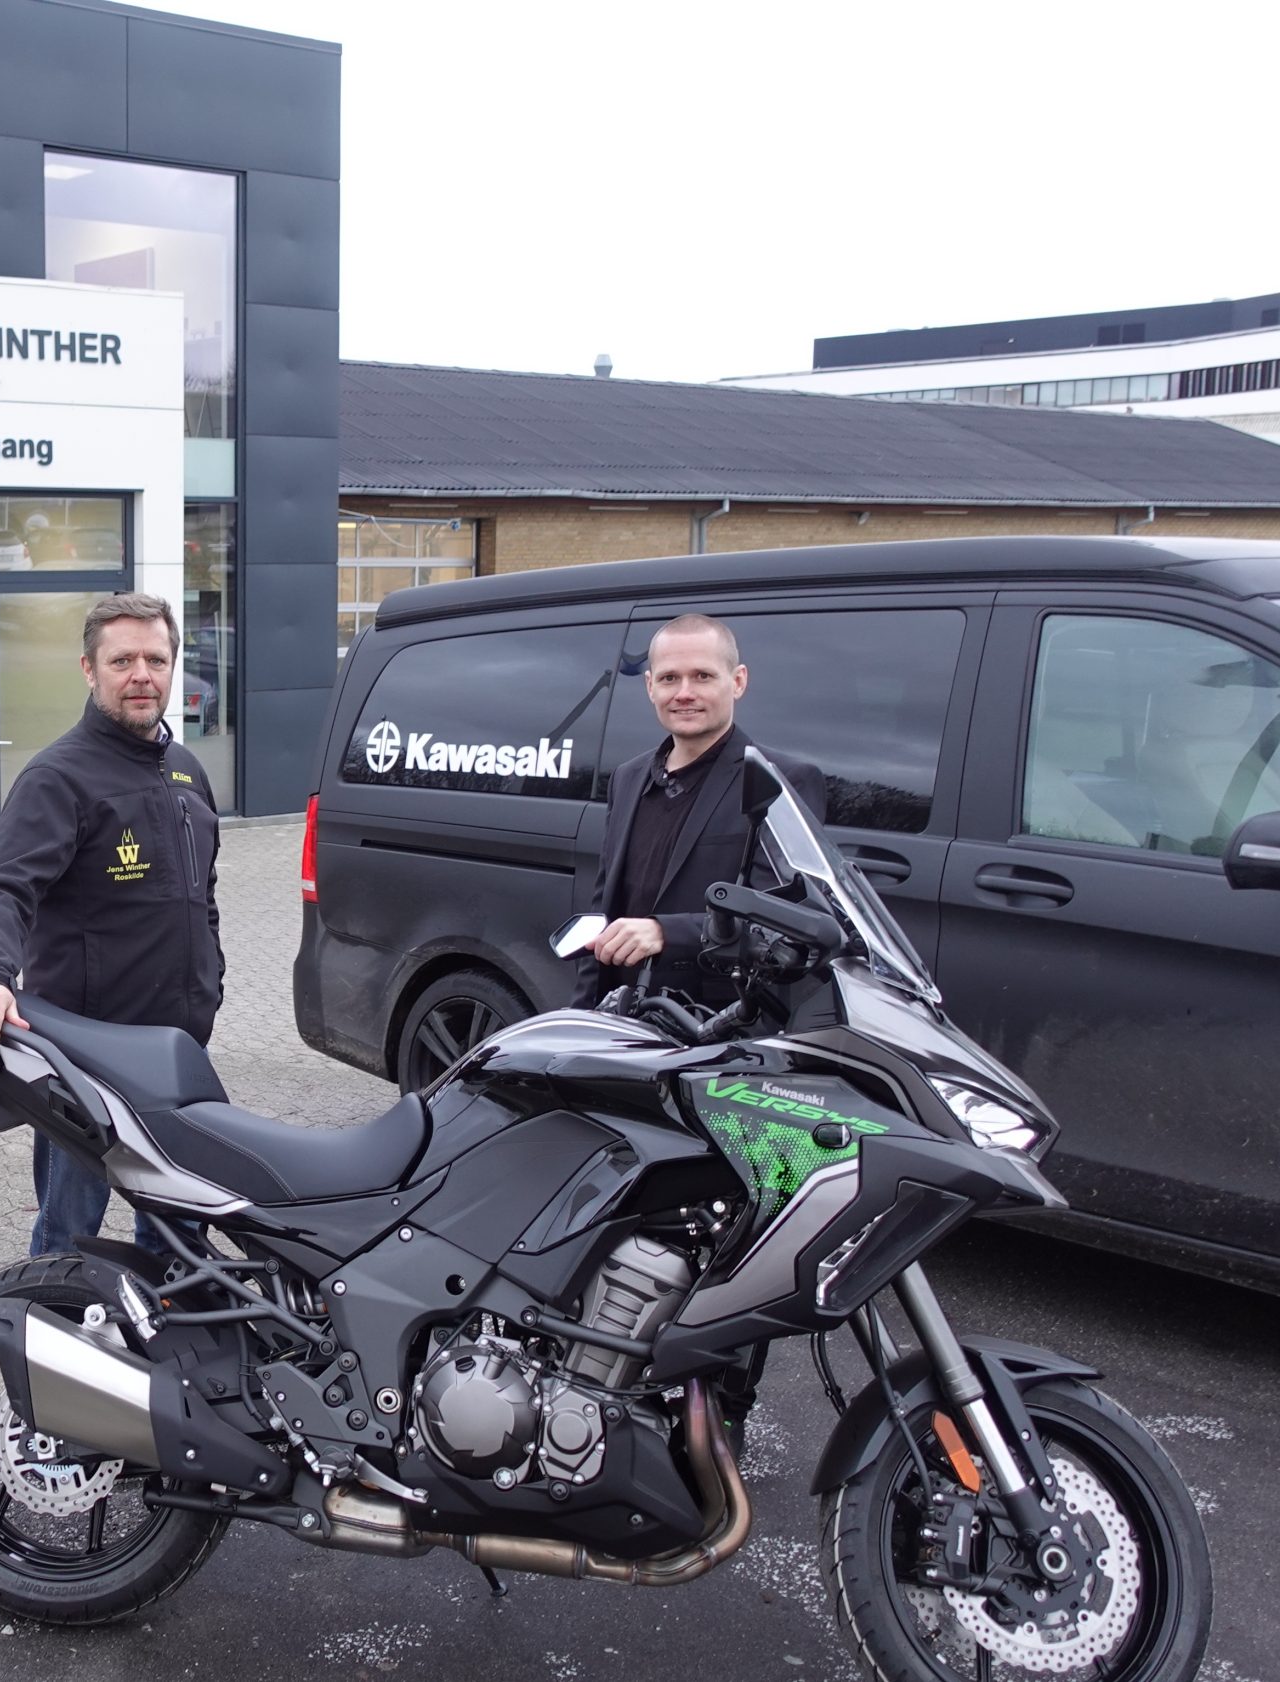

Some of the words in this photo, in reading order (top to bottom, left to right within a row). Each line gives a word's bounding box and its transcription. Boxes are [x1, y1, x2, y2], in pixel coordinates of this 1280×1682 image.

[405, 732, 573, 779] Kawasaki
[106, 865, 124, 873] Jens
[125, 862, 150, 872] Winther
[114, 872, 144, 881] Roskilde
[704, 1078, 891, 1135] VERSYS
[761, 1080, 826, 1107] Kawasaki
